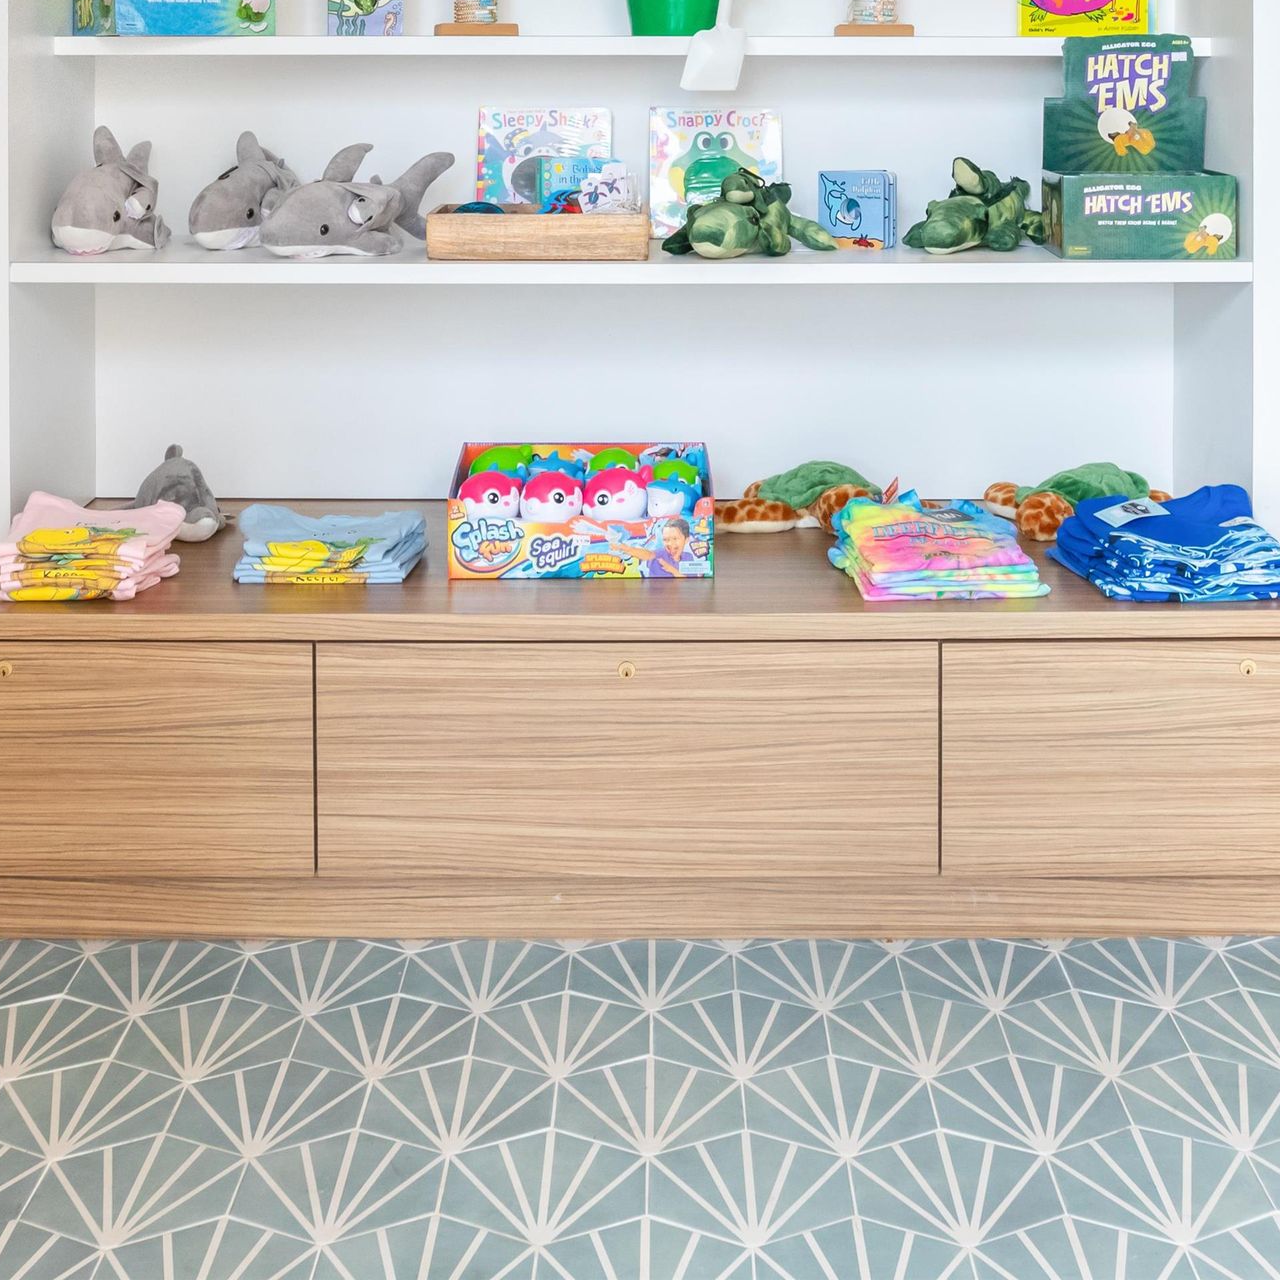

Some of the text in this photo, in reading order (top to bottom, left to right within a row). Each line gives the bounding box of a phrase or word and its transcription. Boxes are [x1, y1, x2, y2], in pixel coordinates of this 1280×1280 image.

[1102, 41, 1140, 50] ALLIGATOR
[1087, 53, 1170, 81] HATCH
[1089, 78, 1167, 113] 'EMS
[492, 110, 599, 129] Sleepy Shk?
[666, 110, 766, 128] Snappy Croc?
[573, 164, 602, 174] Babies
[559, 175, 567, 183] in
[852, 185, 881, 195] Dolphin
[1084, 185, 1124, 193] ALLIGATOR
[1084, 191, 1193, 215] HATCH 'EMS
[452, 518, 524, 562] Splash
[537, 544, 579, 568] squirt
